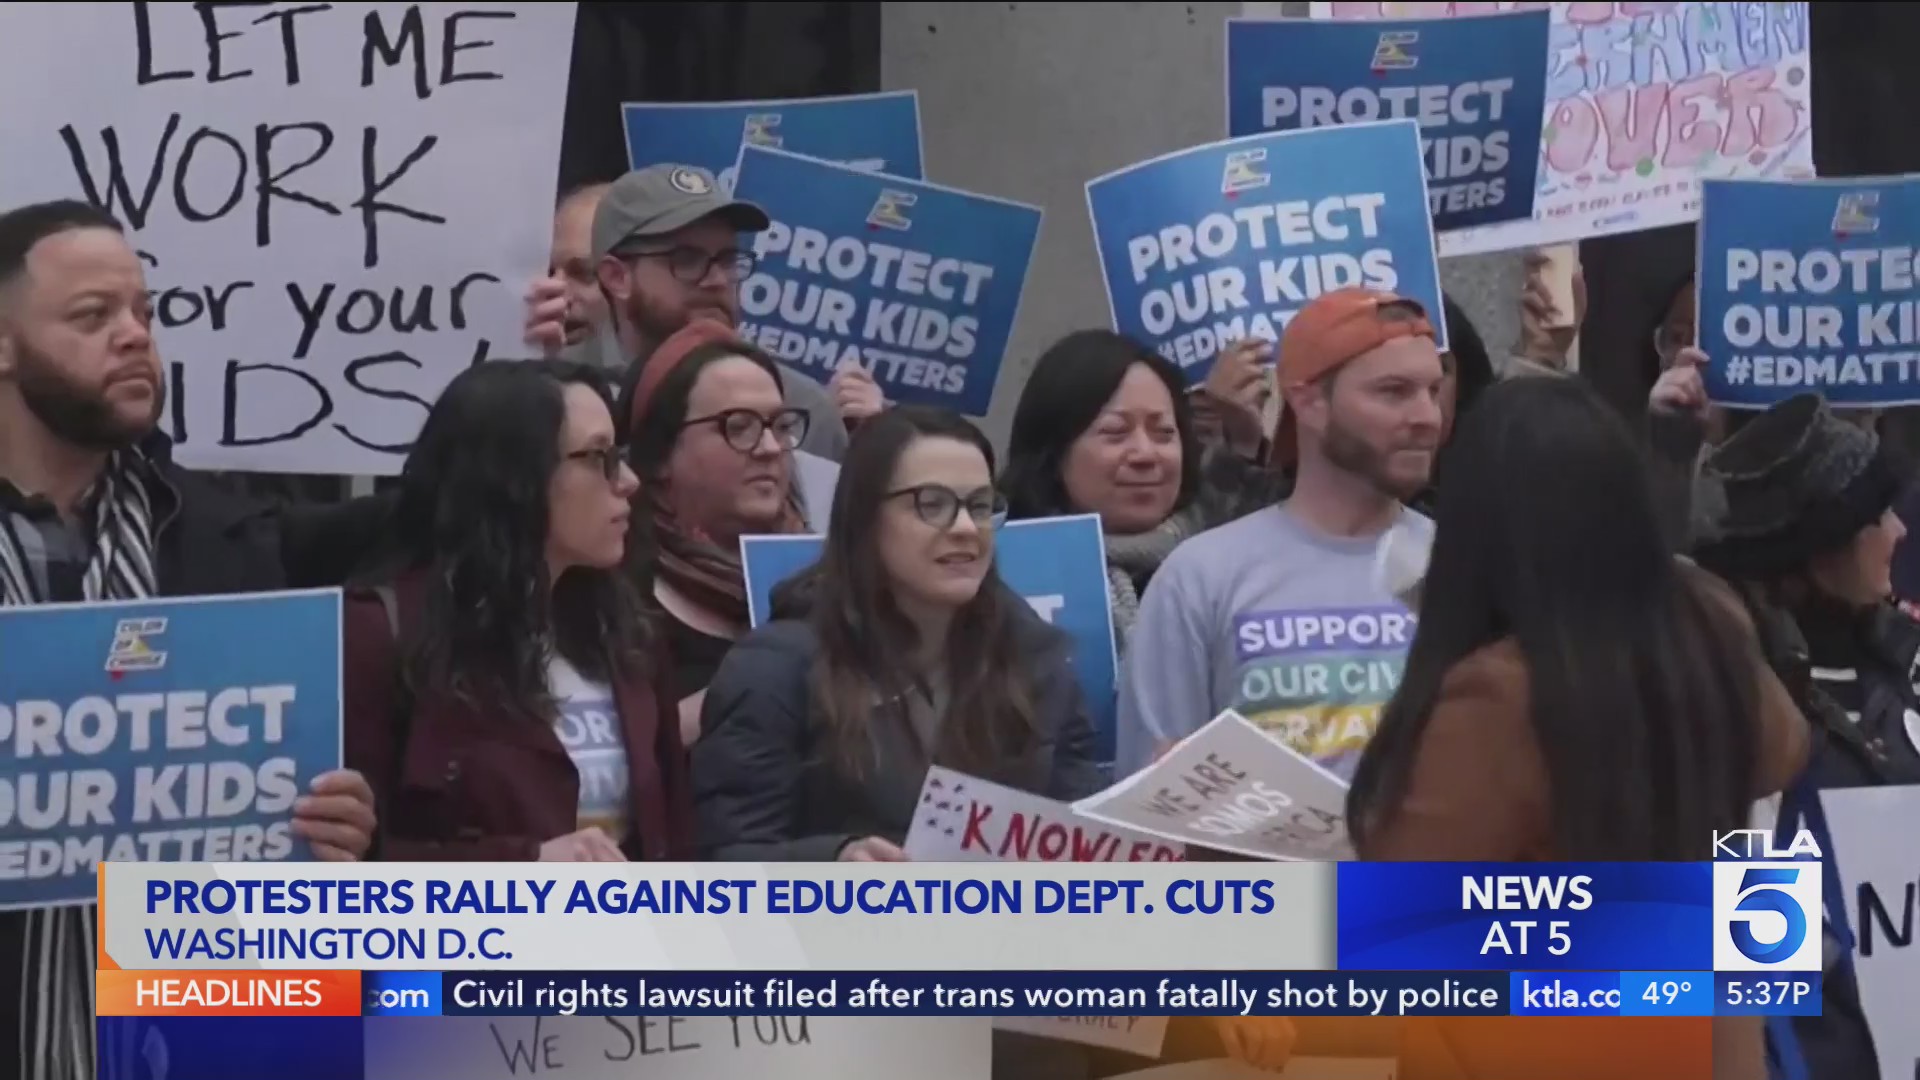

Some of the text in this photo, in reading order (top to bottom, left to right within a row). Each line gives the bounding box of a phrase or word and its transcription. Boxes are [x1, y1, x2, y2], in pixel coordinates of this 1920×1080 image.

[134, 2, 516, 99] LET ME
[1262, 78, 1514, 127] PROTECT
[60, 113, 446, 268] WORK
[753, 220, 994, 305] PROTECT
[1128, 193, 1385, 284] PROTECT
[1727, 247, 1920, 293] PROTE
[287, 272, 500, 359] your
[740, 273, 979, 358] OUR KIDS
[1140, 249, 1398, 335] OUR KIDS
[1723, 302, 1920, 348] OUR KI
[170, 340, 490, 455] IDS
[1726, 352, 1920, 386] #EDMATT
[1239, 612, 1417, 652] SUPPOR
[1242, 660, 1400, 701] OUR CIV
[131, 758, 297, 824] KIDS
[1180, 753, 1247, 800] ARE
[490, 1016, 564, 1074] WE
[604, 1016, 700, 1060] SEE
